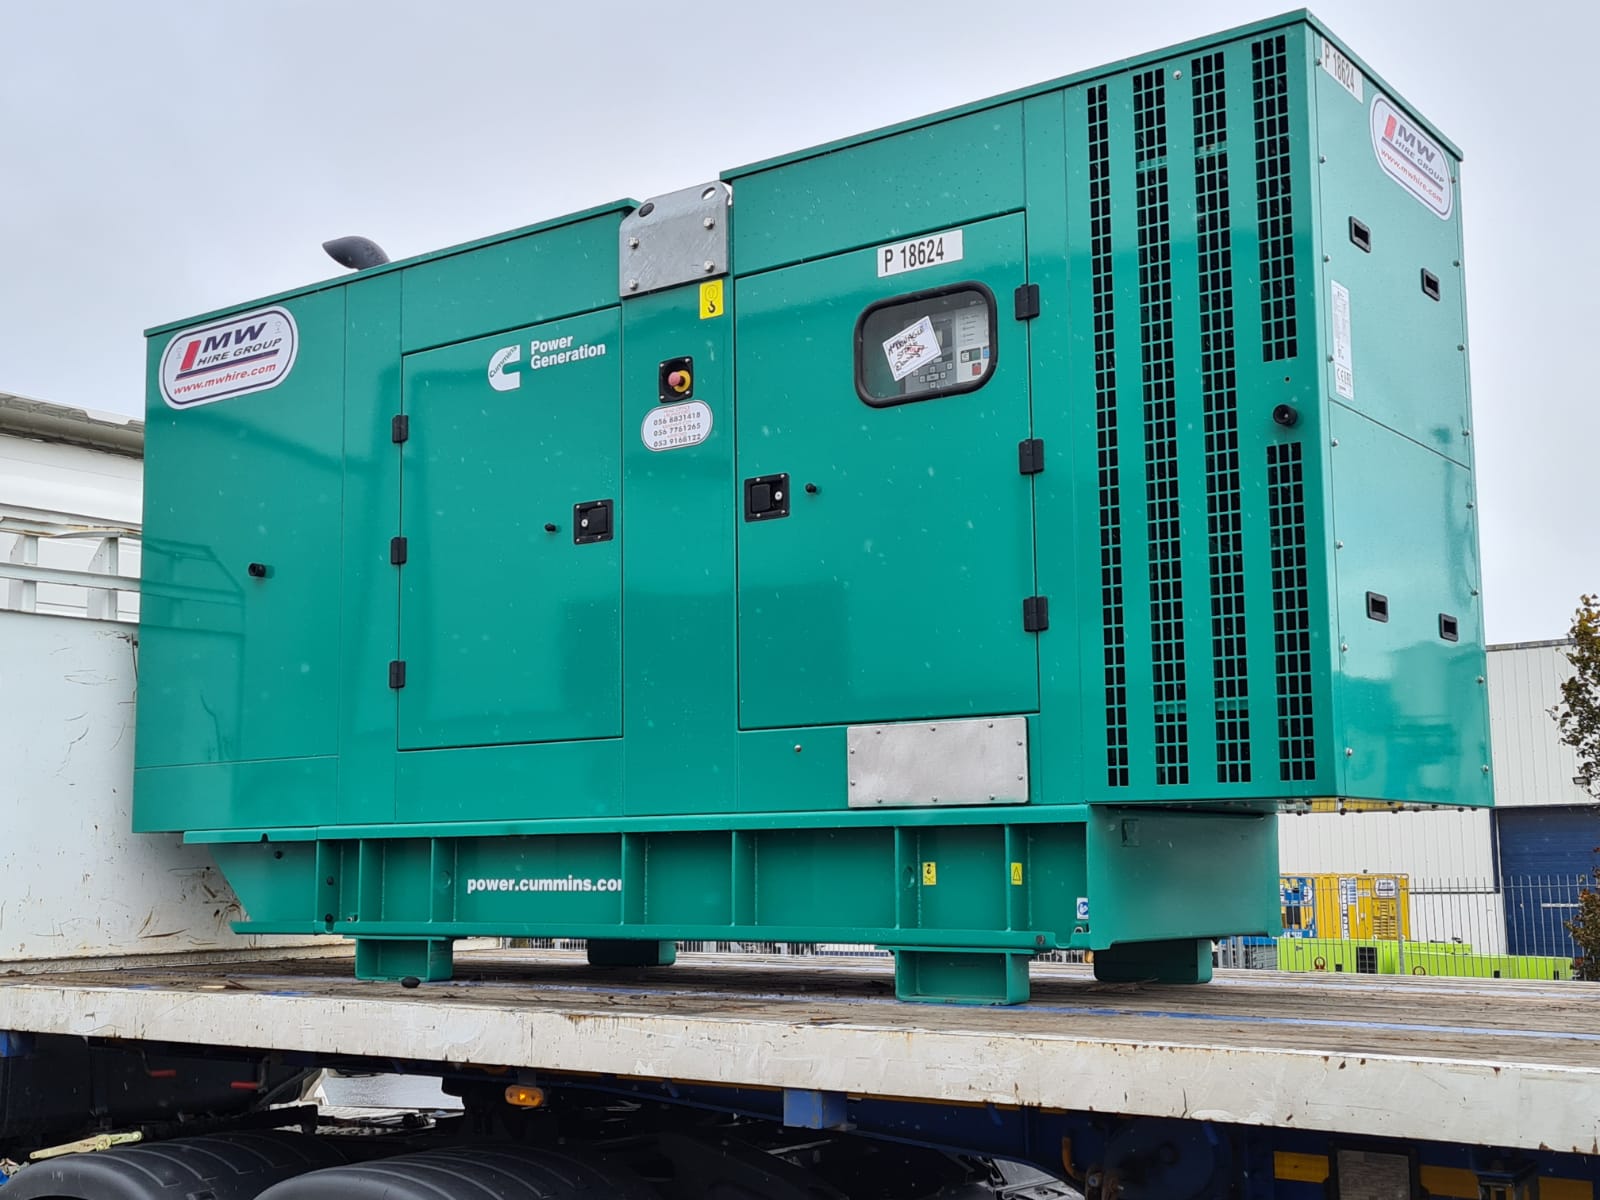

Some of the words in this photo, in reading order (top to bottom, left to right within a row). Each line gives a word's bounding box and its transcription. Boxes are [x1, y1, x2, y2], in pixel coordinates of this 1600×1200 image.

[1333, 52, 1355, 92] 18624
[1398, 125, 1435, 163] MW
[1380, 149, 1444, 205] www.mwhire.com
[1394, 140, 1416, 158] HIRE
[1417, 159, 1445, 183] GROUP
[884, 249, 894, 273] P
[900, 237, 944, 269] 18624
[197, 352, 230, 367] HIRE
[233, 337, 283, 357] GROUP
[202, 322, 267, 353] MW
[530, 336, 574, 355] Power
[530, 343, 607, 370] Generation
[173, 363, 277, 395] www.mwhire.com
[653, 418, 667, 426] 056
[653, 429, 667, 437] 056
[653, 440, 667, 448] 053
